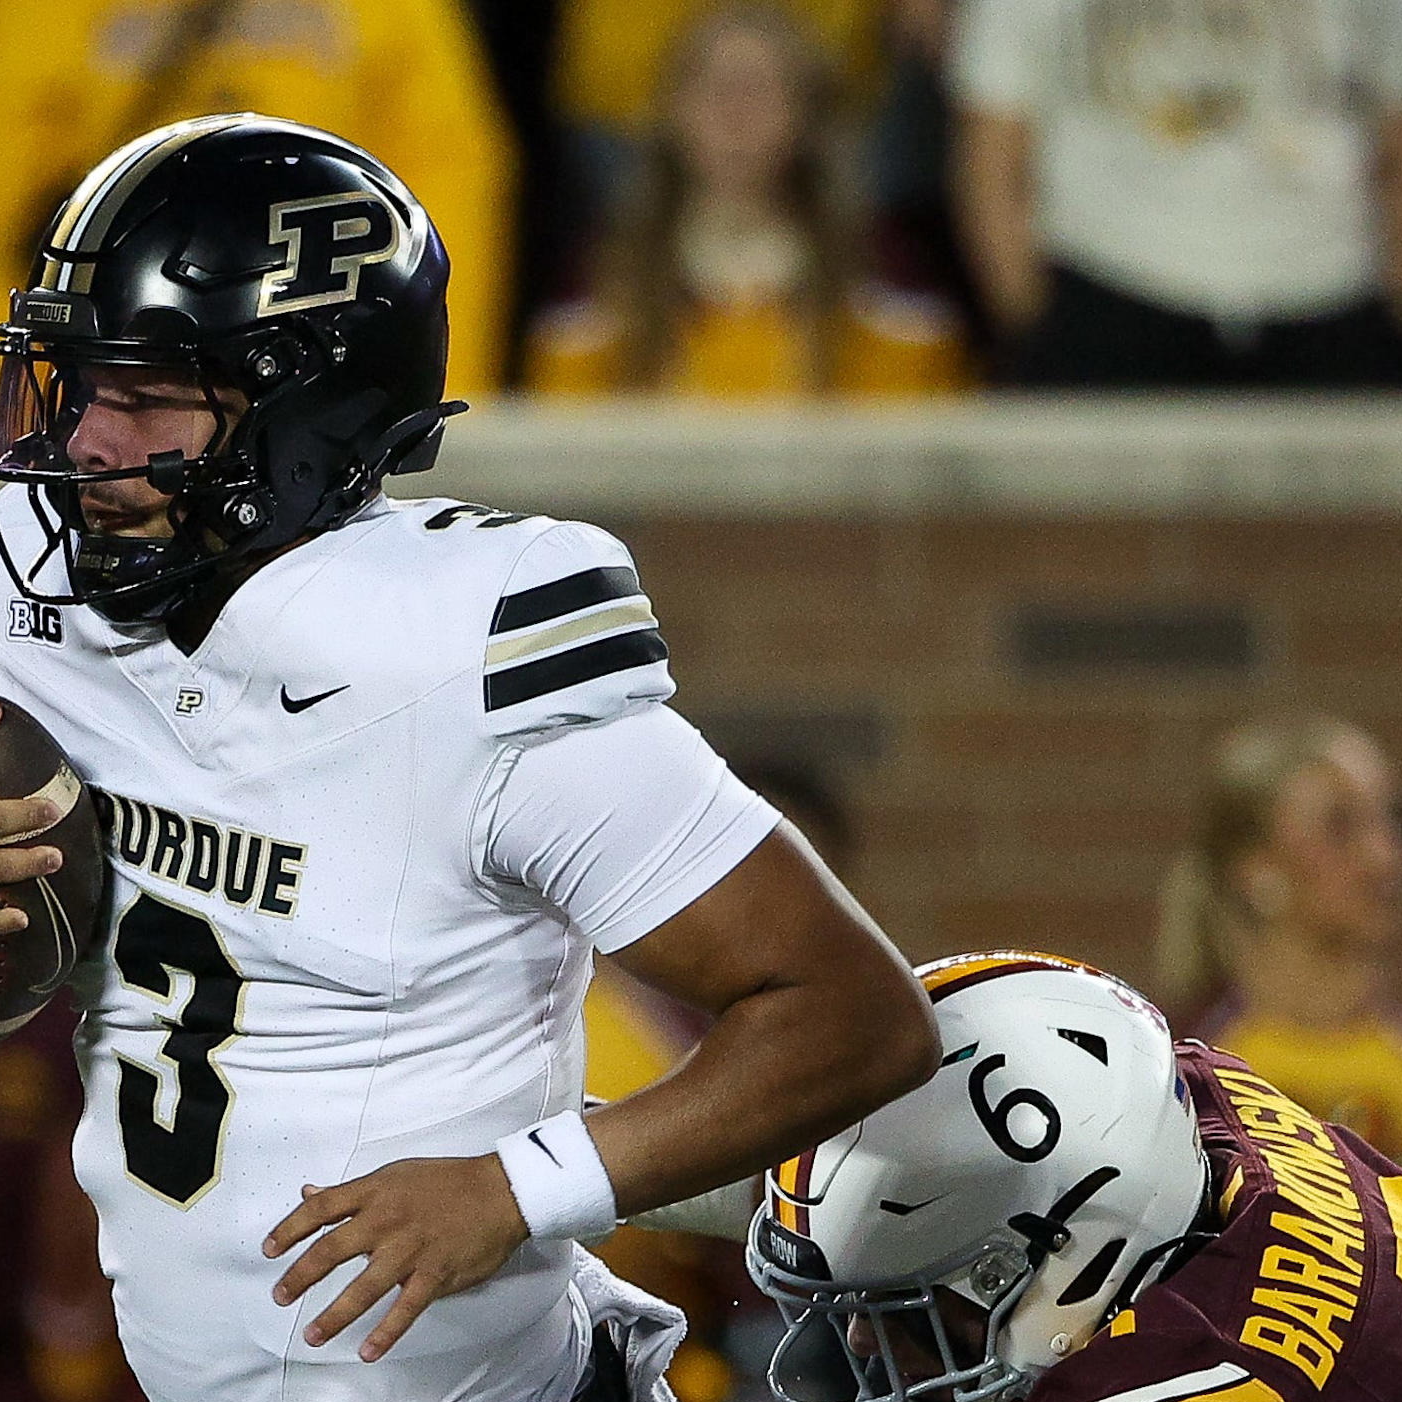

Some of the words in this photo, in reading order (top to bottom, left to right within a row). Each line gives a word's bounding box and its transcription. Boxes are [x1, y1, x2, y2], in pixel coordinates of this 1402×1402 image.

[257, 191, 400, 319] P
[174, 686, 205, 715] P
[113, 888, 243, 1212] 3
[967, 1053, 1062, 1163] 6
[770, 1231, 798, 1268] ROW
